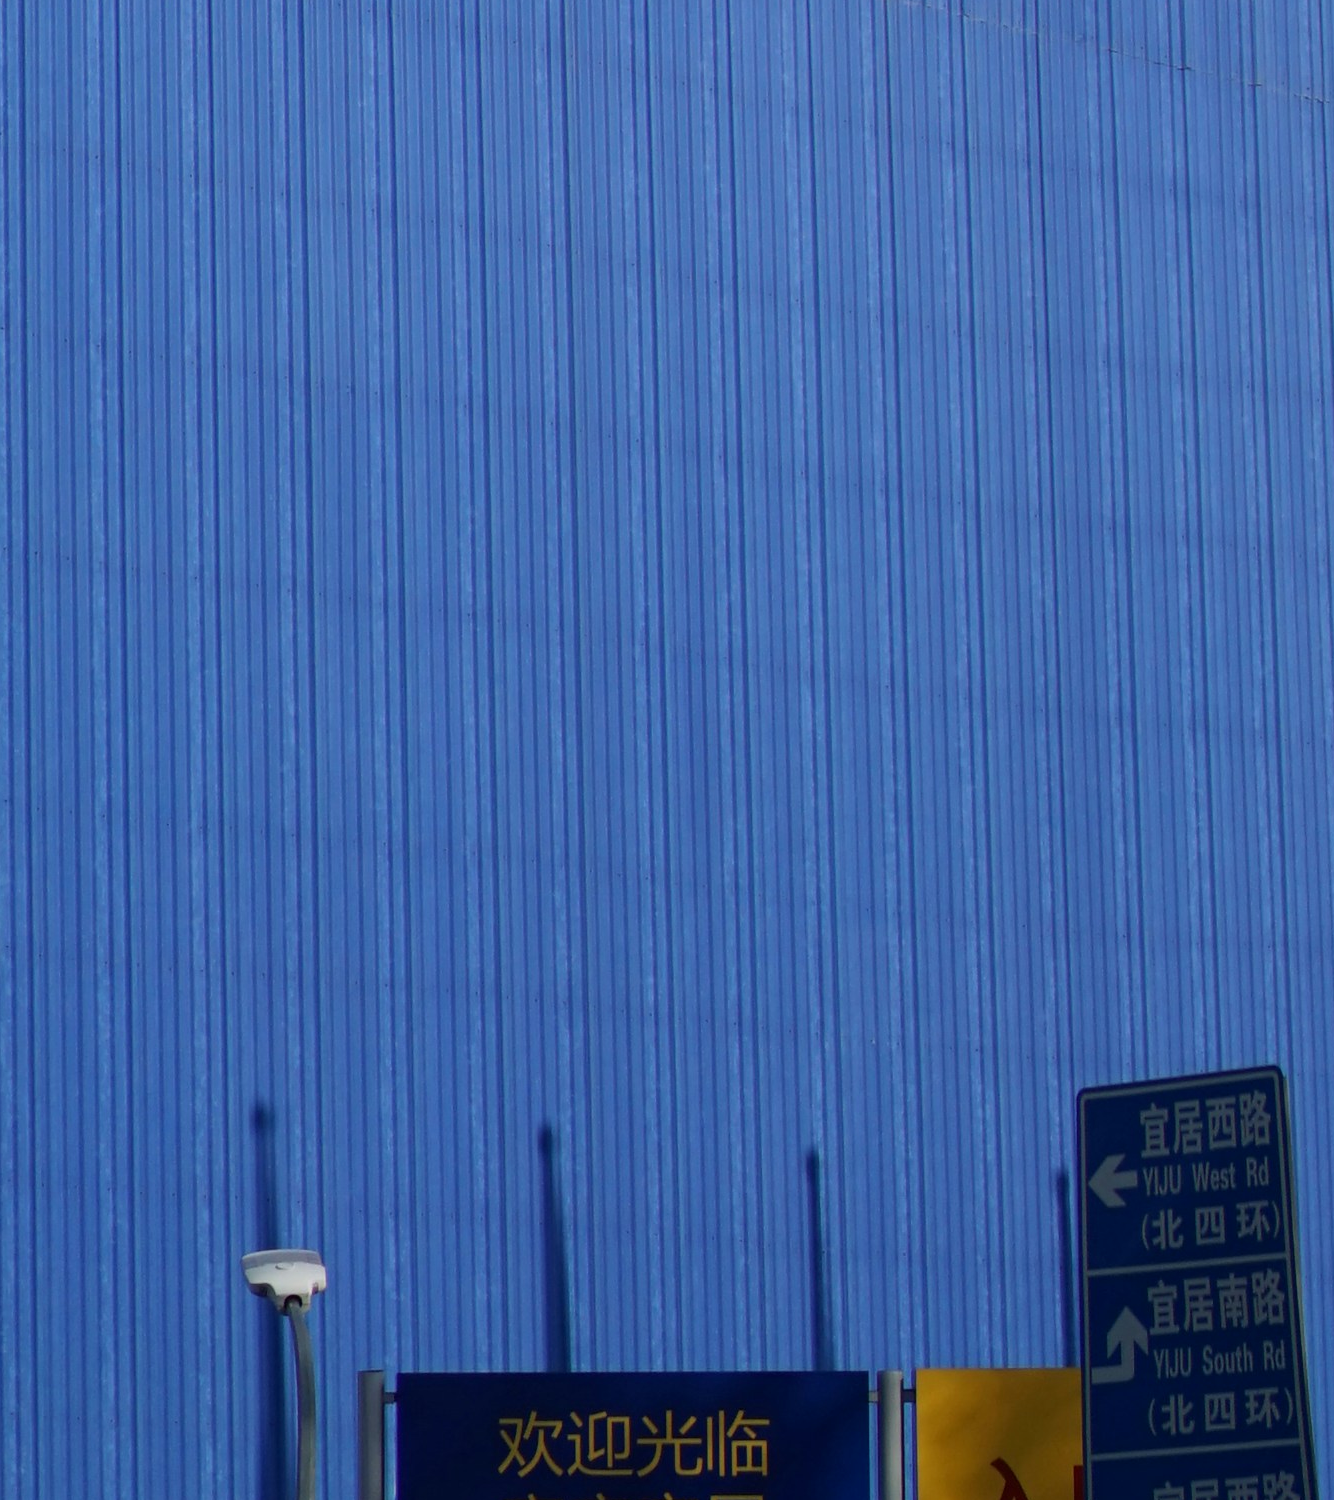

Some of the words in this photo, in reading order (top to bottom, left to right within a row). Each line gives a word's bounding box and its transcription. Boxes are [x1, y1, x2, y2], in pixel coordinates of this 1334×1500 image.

[1140, 1089, 1271, 1158] 宜居西路
[1143, 1164, 1182, 1197] YIJU
[1192, 1161, 1236, 1193] West
[1246, 1156, 1269, 1189] Rd
[1147, 1268, 1285, 1336] 宜居南路
[1153, 1347, 1192, 1379] YIJU
[1202, 1342, 1254, 1376] South
[1263, 1339, 1287, 1371] Rd
[498, 1410, 770, 1478] 欢迎光临
